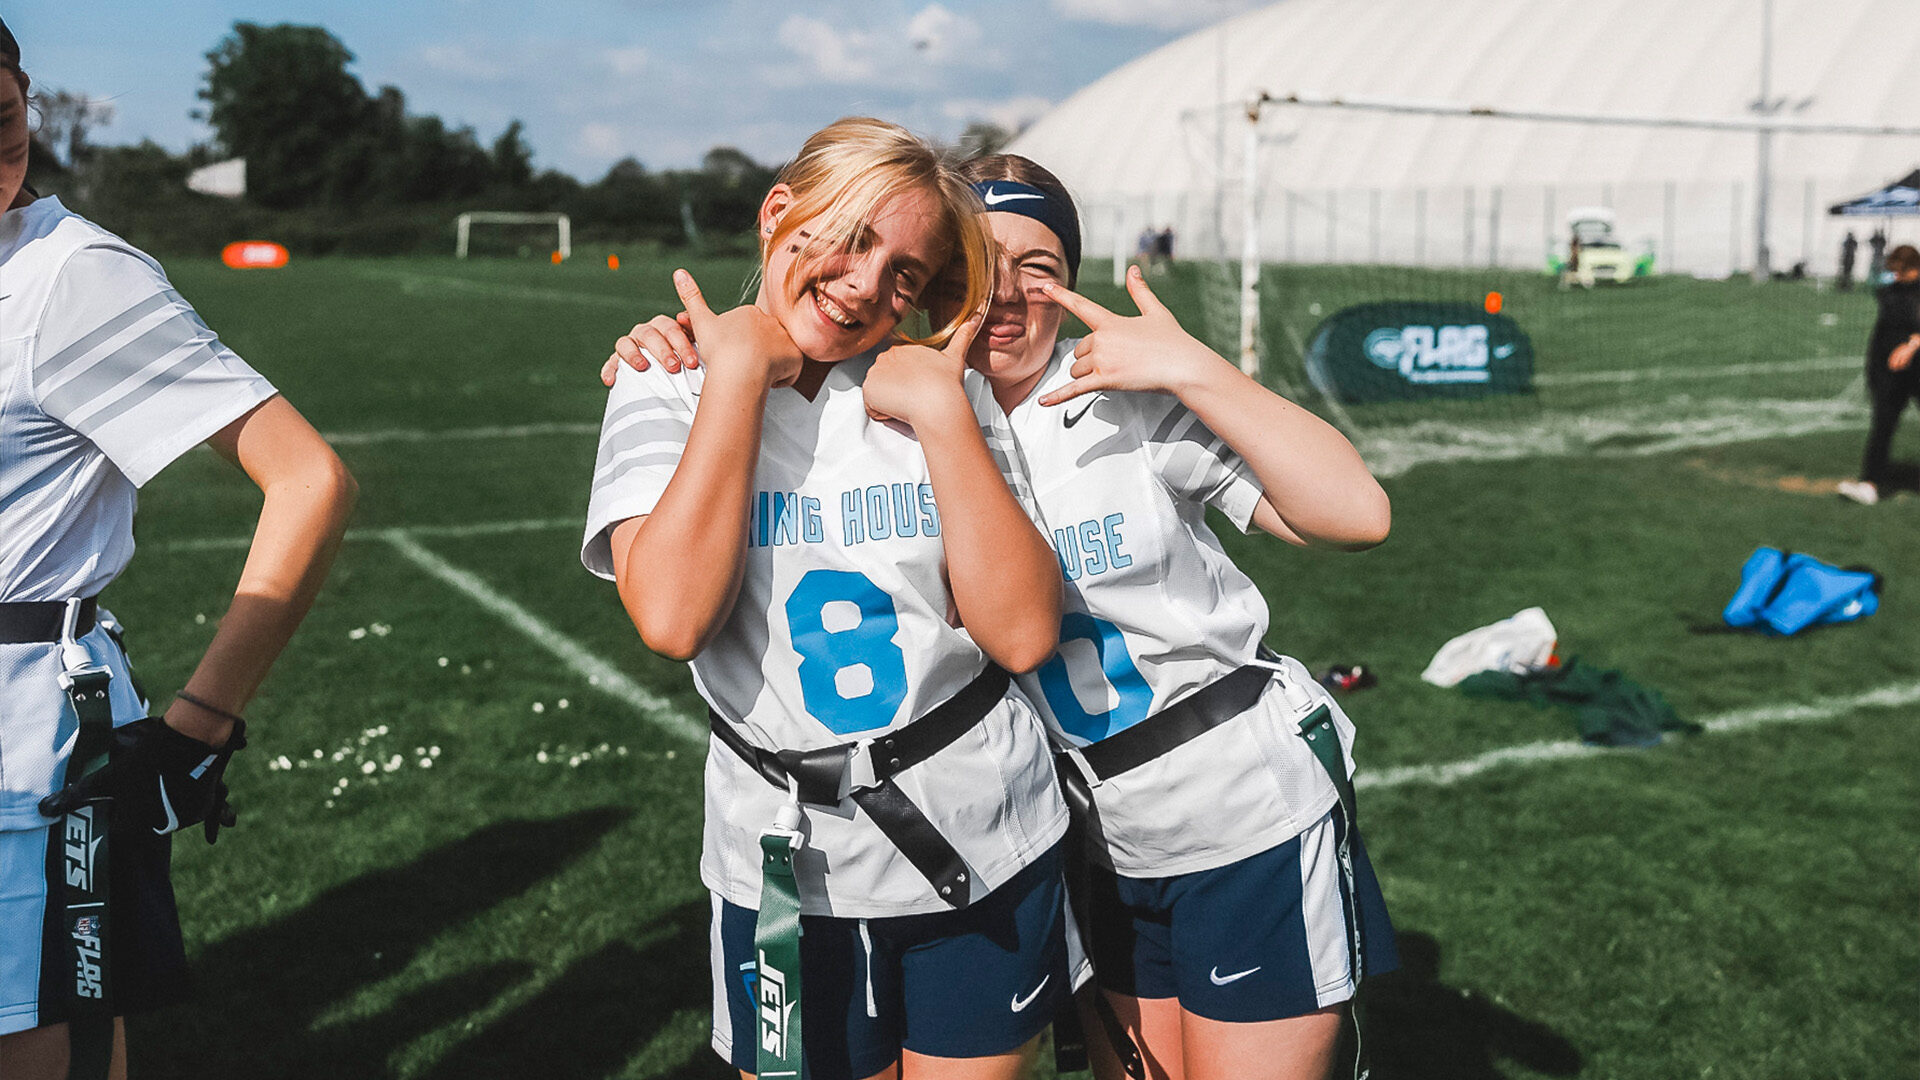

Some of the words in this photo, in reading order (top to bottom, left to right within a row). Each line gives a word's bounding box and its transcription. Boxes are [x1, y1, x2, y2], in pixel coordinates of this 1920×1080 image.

[748, 491, 823, 547] ING
[785, 569, 908, 735] 8
[1038, 612, 1154, 742] 0
[71, 932, 103, 999] FLAG
[759, 948, 797, 1061] JETS
